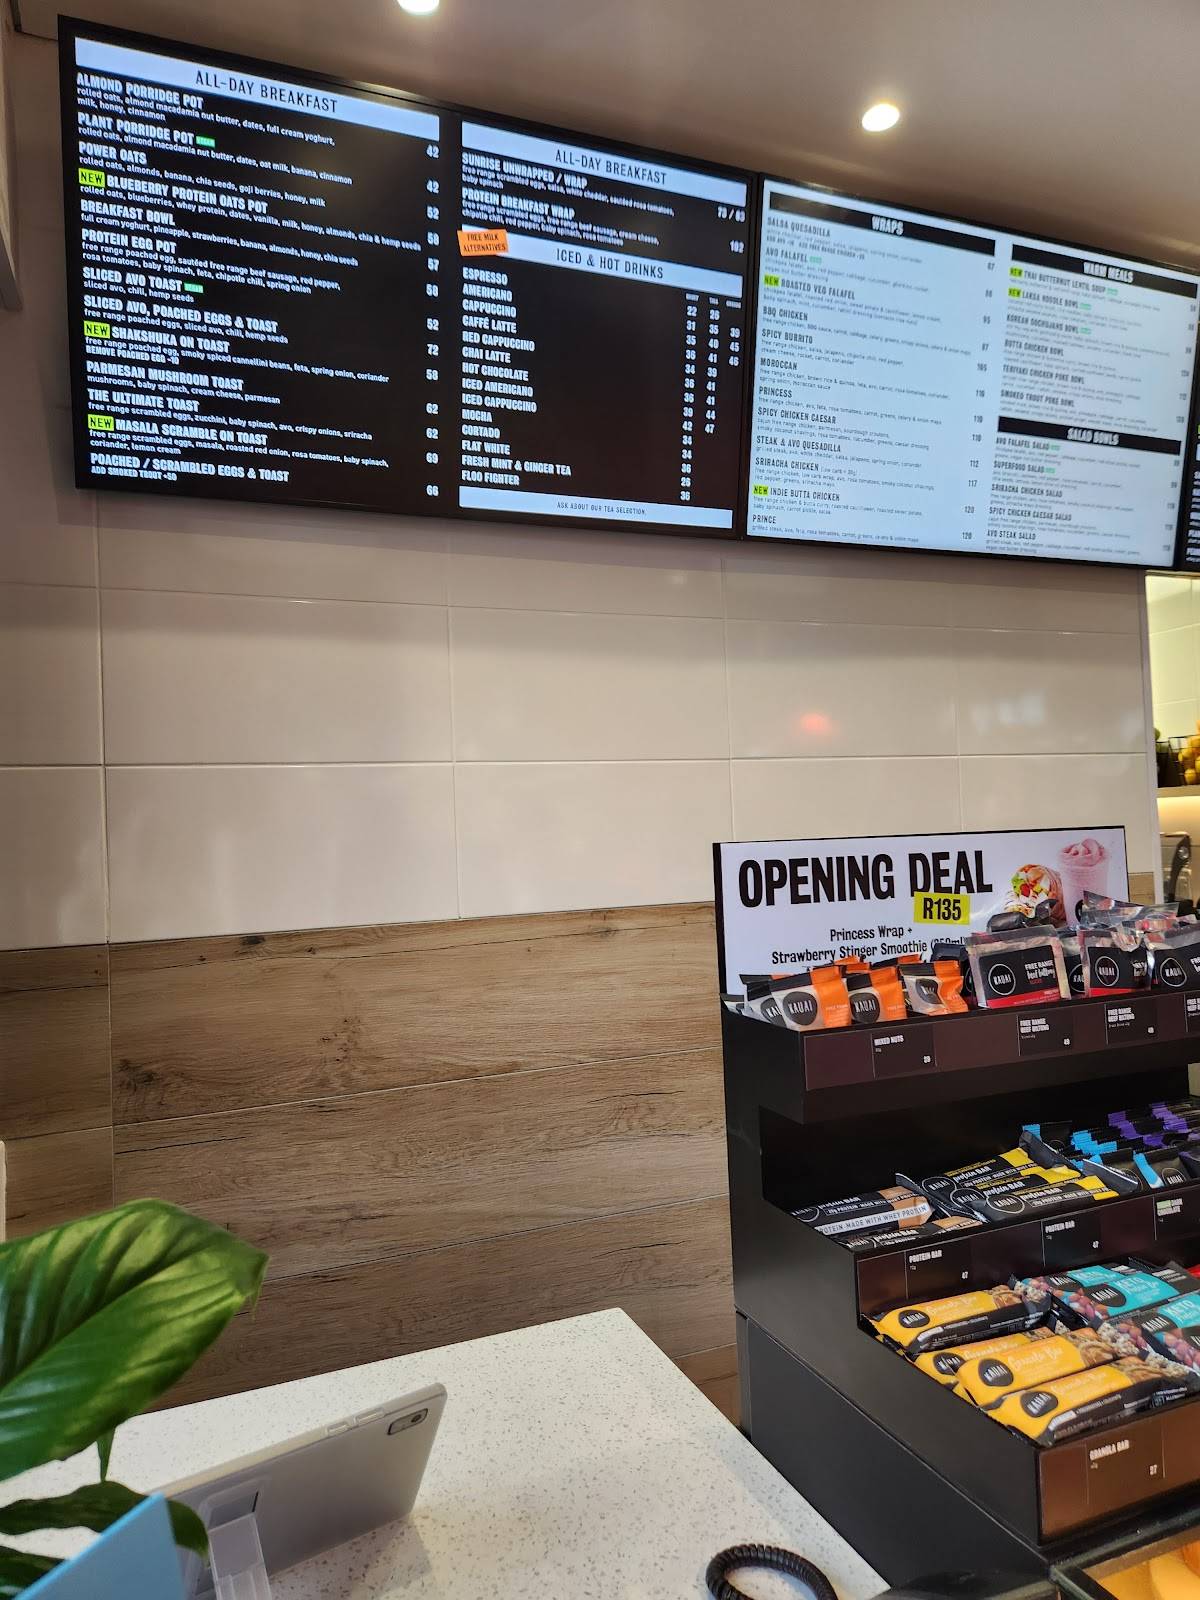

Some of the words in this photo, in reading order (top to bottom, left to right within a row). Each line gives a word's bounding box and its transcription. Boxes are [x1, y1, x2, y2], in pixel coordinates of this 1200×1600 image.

[76, 71, 123, 93] ALMOND
[125, 81, 180, 105] PORRIDGE
[182, 93, 203, 110] POT
[195, 69, 254, 95] ALL-DAY
[260, 83, 337, 113] BREAKFAST
[77, 111, 113, 130] PLANT
[115, 118, 170, 141] PORRIDGE
[172, 129, 194, 145] POT
[78, 140, 117, 160] POWER
[119, 148, 147, 165] OATS
[426, 143, 439, 158] 42
[461, 151, 501, 172] SUNRISE
[502, 160, 554, 182] UNWRAPPED
[555, 172, 562, 184] /
[563, 173, 587, 189] WRAP
[554, 148, 601, 171] ALL-DAY
[605, 159, 667, 185] BREAKFAST
[80, 170, 102, 184] NEW
[106, 174, 169, 196] BLUEBERRY
[171, 185, 217, 205] PROTEIN
[218, 194, 245, 210] OATS
[247, 198, 268, 214] POT
[426, 179, 439, 193] 42
[461, 186, 499, 206] PROTEIN
[500, 194, 549, 215] BREAKFAST
[550, 204, 575, 220] WRAP
[80, 198, 143, 221] BREAKFAST
[145, 209, 175, 226] BOWL
[426, 205, 439, 220] 52
[871, 215, 903, 235] WRAPS
[81, 227, 128, 247] PROTEIN
[130, 235, 153, 250] EGG
[155, 238, 177, 254] POT
[556, 247, 582, 264] ICED
[586, 253, 595, 267] &
[599, 255, 620, 271] HOT
[624, 260, 663, 279] DRINKS
[82, 265, 122, 283] SLICED
[124, 272, 146, 286] AVO
[147, 275, 182, 292] TOAST
[462, 266, 508, 285] ESPRESSO
[461, 282, 512, 302] AMERICANO
[461, 298, 516, 318] CAPPUCCINO
[762, 305, 776, 316] BBQ
[778, 307, 808, 321] CHICKEN
[85, 323, 108, 336] NEW
[761, 327, 782, 339] SPICY
[784, 331, 813, 344] BURRITO
[111, 325, 177, 346] SHAKSHUKA
[179, 334, 194, 348] ON
[195, 336, 230, 353] TOAST
[426, 343, 439, 356] 72
[85, 360, 145, 379] PARMESAN
[147, 367, 209, 387] MUSHROOM
[210, 375, 244, 391] TOAST
[86, 387, 109, 402] THE
[111, 390, 164, 408] ULTIMATE
[165, 396, 200, 412] TOAST
[758, 385, 792, 398] PRINCESS
[89, 416, 111, 428] NEW
[461, 408, 492, 422] MOCHA
[114, 418, 159, 434] MASALA
[160, 423, 218, 441] SCRAMBLE
[218, 429, 234, 442] ON
[235, 431, 268, 445] TOAST
[461, 423, 500, 439] CORTADO
[1066, 427, 1092, 442] SALAD
[1092, 430, 1119, 445] BOWLS
[461, 439, 482, 452] FLAT
[483, 441, 510, 455] WHITE
[753, 485, 768, 494] NEW
[967, 479, 978, 487] 117
[769, 487, 788, 497] INDIE
[789, 488, 810, 499] BUTTA
[812, 491, 840, 501] CHICKEN
[752, 513, 776, 524] PRINCE
[738, 854, 895, 908] OPENING
[908, 850, 993, 897] DEAL
[922, 897, 962, 921] R135
[830, 927, 875, 942] Princess
[878, 925, 904, 938] Wrap
[772, 945, 836, 965] Strawberry
[839, 944, 877, 959] Stinger
[880, 940, 928, 955] Smoothie
[993, 974, 1011, 985] KAUAI
[788, 1000, 813, 1014] KAUAI
[854, 999, 876, 1013] KAUAI
[928, 1180, 950, 1191] KAUAI
[866, 1216, 882, 1225] WITH
[883, 1212, 901, 1221] WHEY
[909, 1252, 931, 1263] PROTEIN
[931, 1250, 942, 1258] BAR
[1091, 1287, 1119, 1301] KAUAI
[904, 1312, 926, 1325] KAUAI
[1141, 1316, 1169, 1332] KAUAI
[984, 1366, 1008, 1382] KAUAI
[1028, 1393, 1051, 1414] KAUAI
[1089, 1443, 1117, 1461] GRANOLA
[1117, 1439, 1130, 1452] BAR
